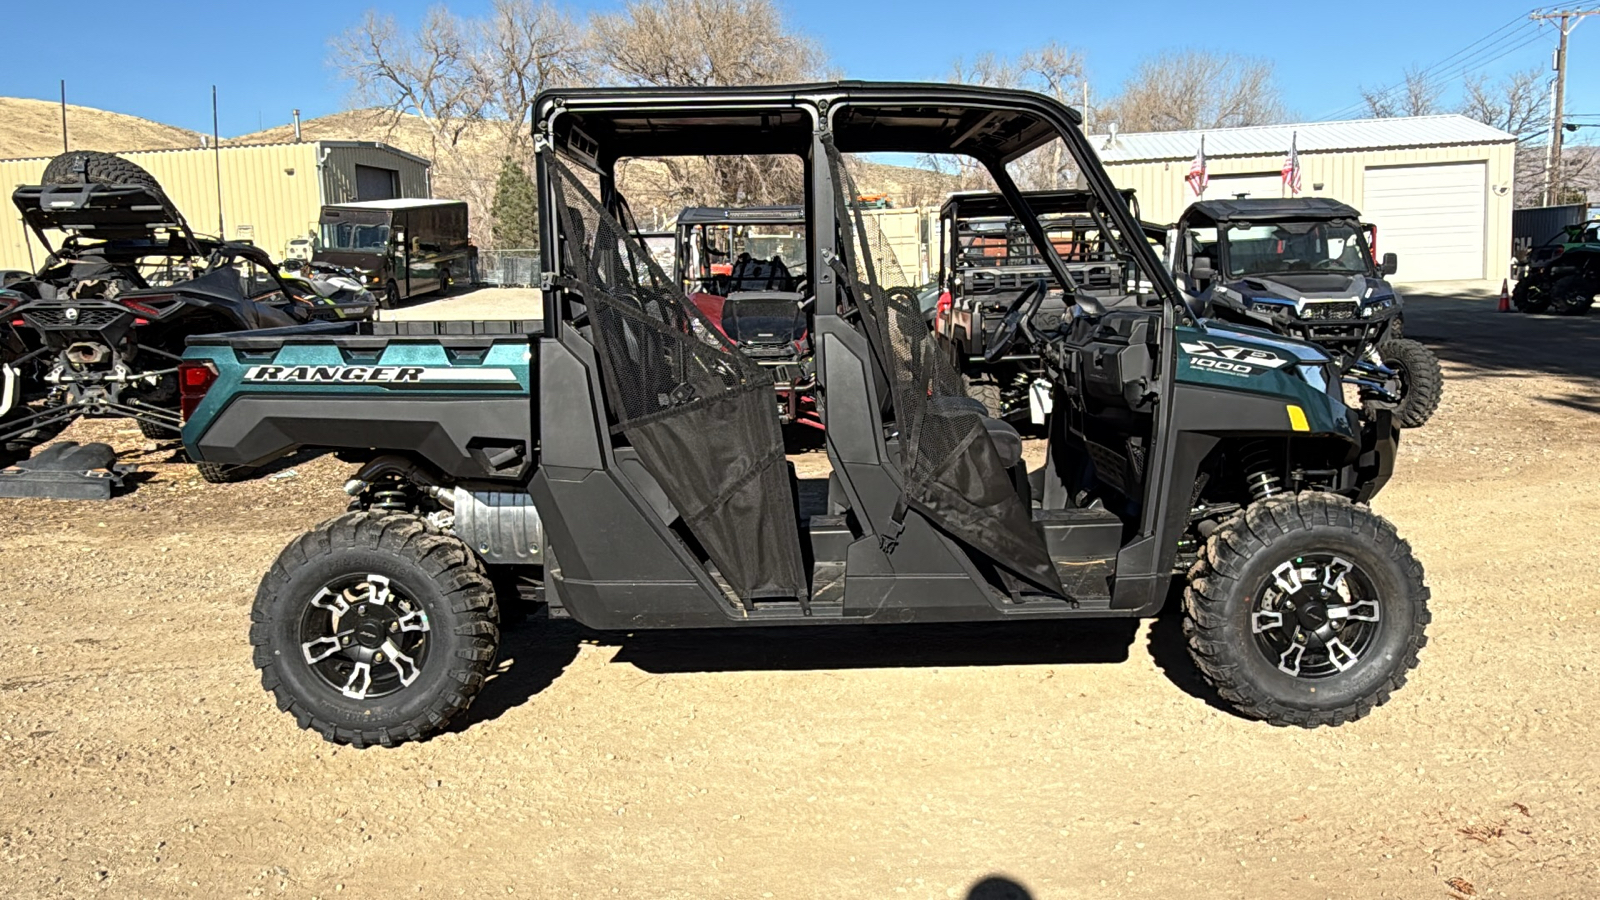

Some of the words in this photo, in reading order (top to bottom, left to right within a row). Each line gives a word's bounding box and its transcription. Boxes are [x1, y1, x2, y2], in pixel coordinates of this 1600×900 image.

[1190, 341, 1277, 360] XP
[253, 365, 425, 382] RANGER
[1190, 357, 1252, 373] 1000
